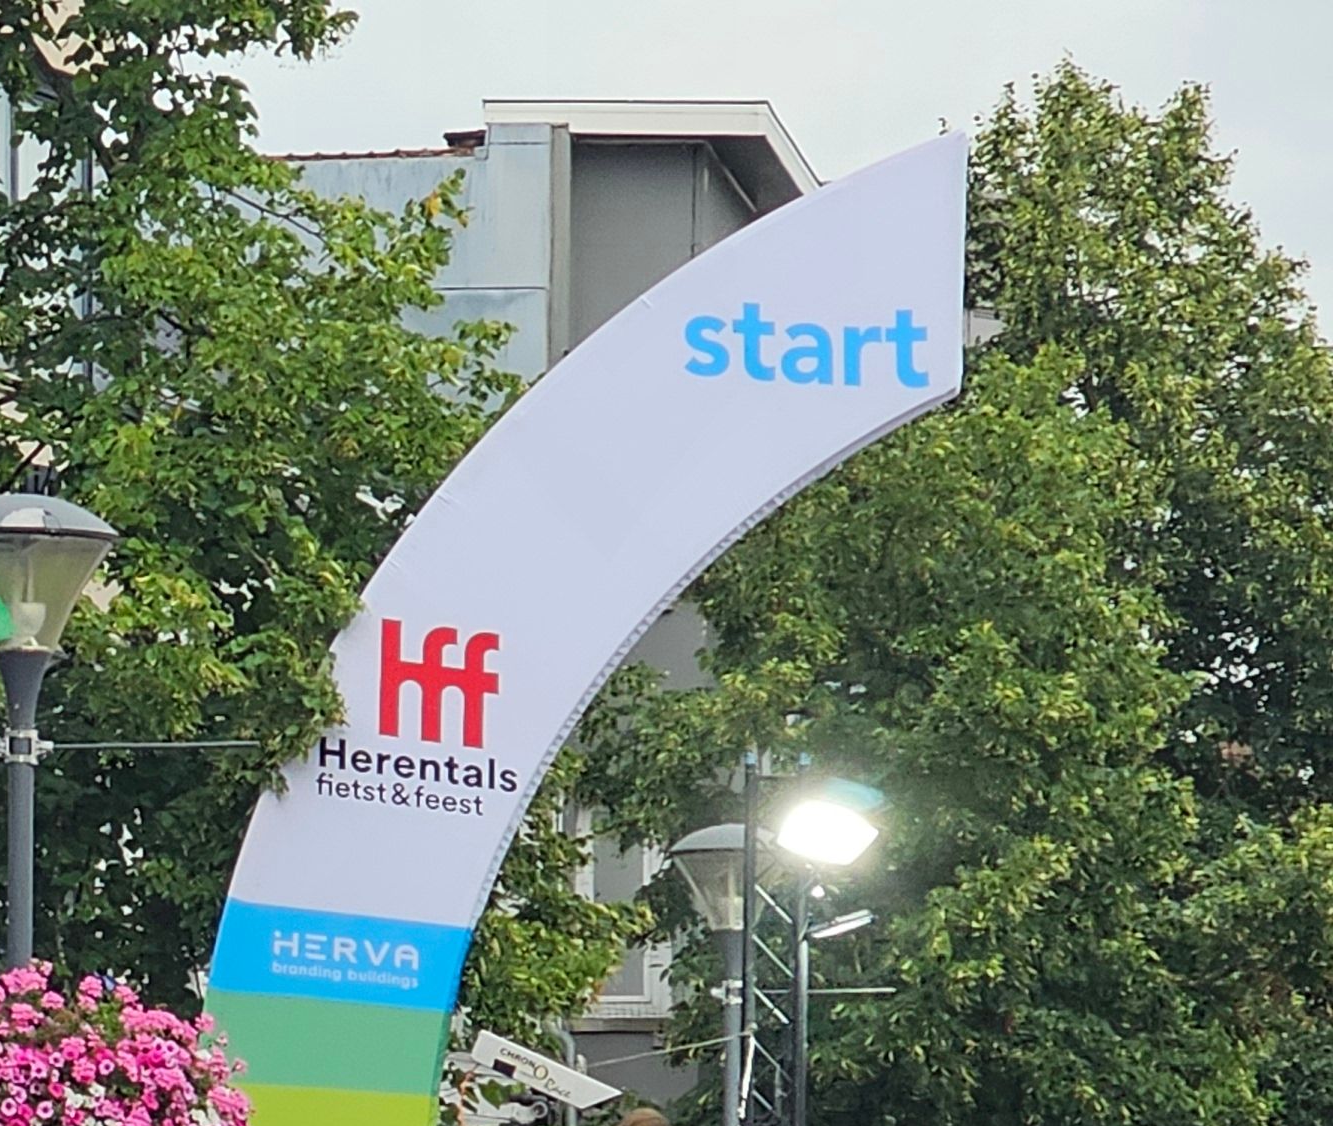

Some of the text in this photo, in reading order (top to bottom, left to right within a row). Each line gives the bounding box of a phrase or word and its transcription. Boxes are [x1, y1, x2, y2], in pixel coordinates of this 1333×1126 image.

[683, 301, 931, 389] start
[378, 617, 501, 749] hff
[318, 735, 518, 793] Herentals
[271, 960, 420, 990] branding buildings
[272, 929, 420, 971] HERVA
